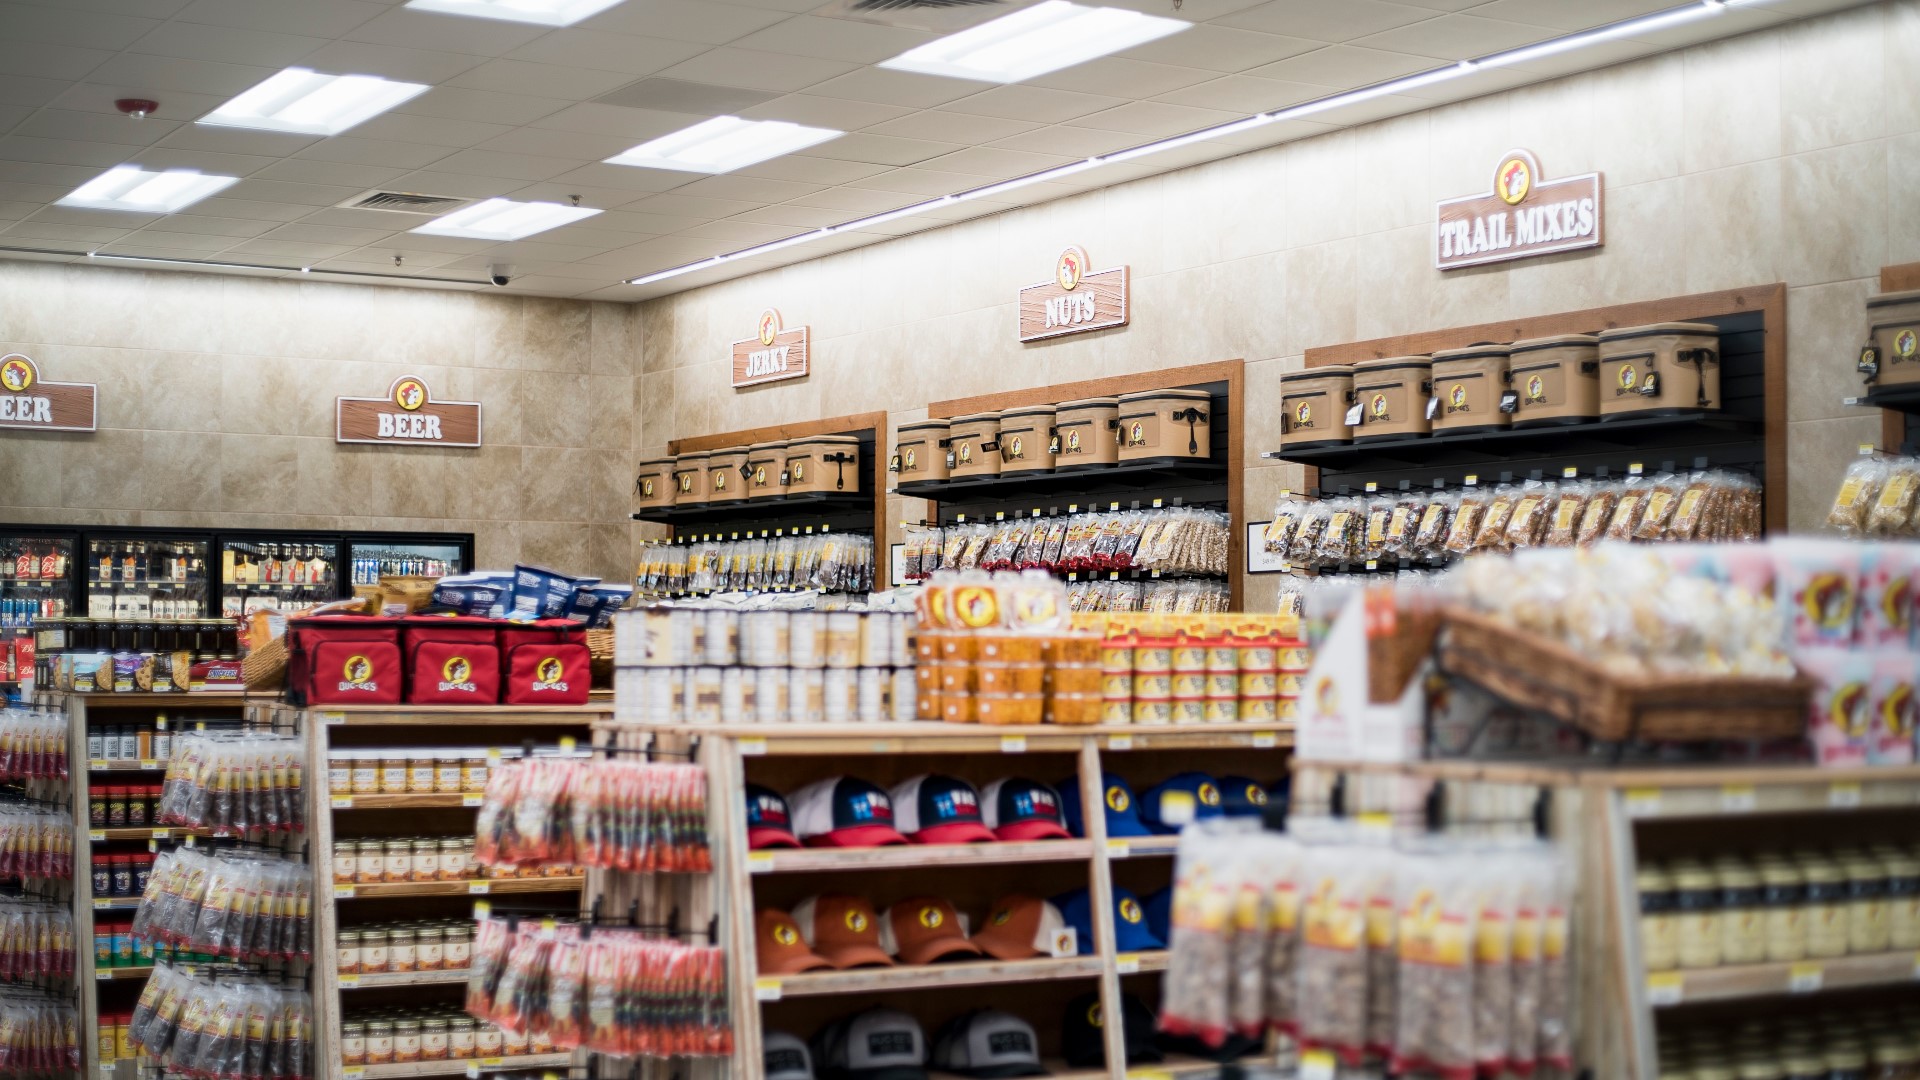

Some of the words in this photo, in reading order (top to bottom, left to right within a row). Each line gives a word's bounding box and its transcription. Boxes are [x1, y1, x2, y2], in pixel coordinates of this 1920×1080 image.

[1440, 212, 1512, 257] TRAIL
[1515, 197, 1593, 246] MIXES
[1045, 291, 1095, 329] NUTS
[746, 345, 790, 377] JERKY
[377, 413, 443, 439] BEER
[208, 669, 238, 678] SNICKERS
